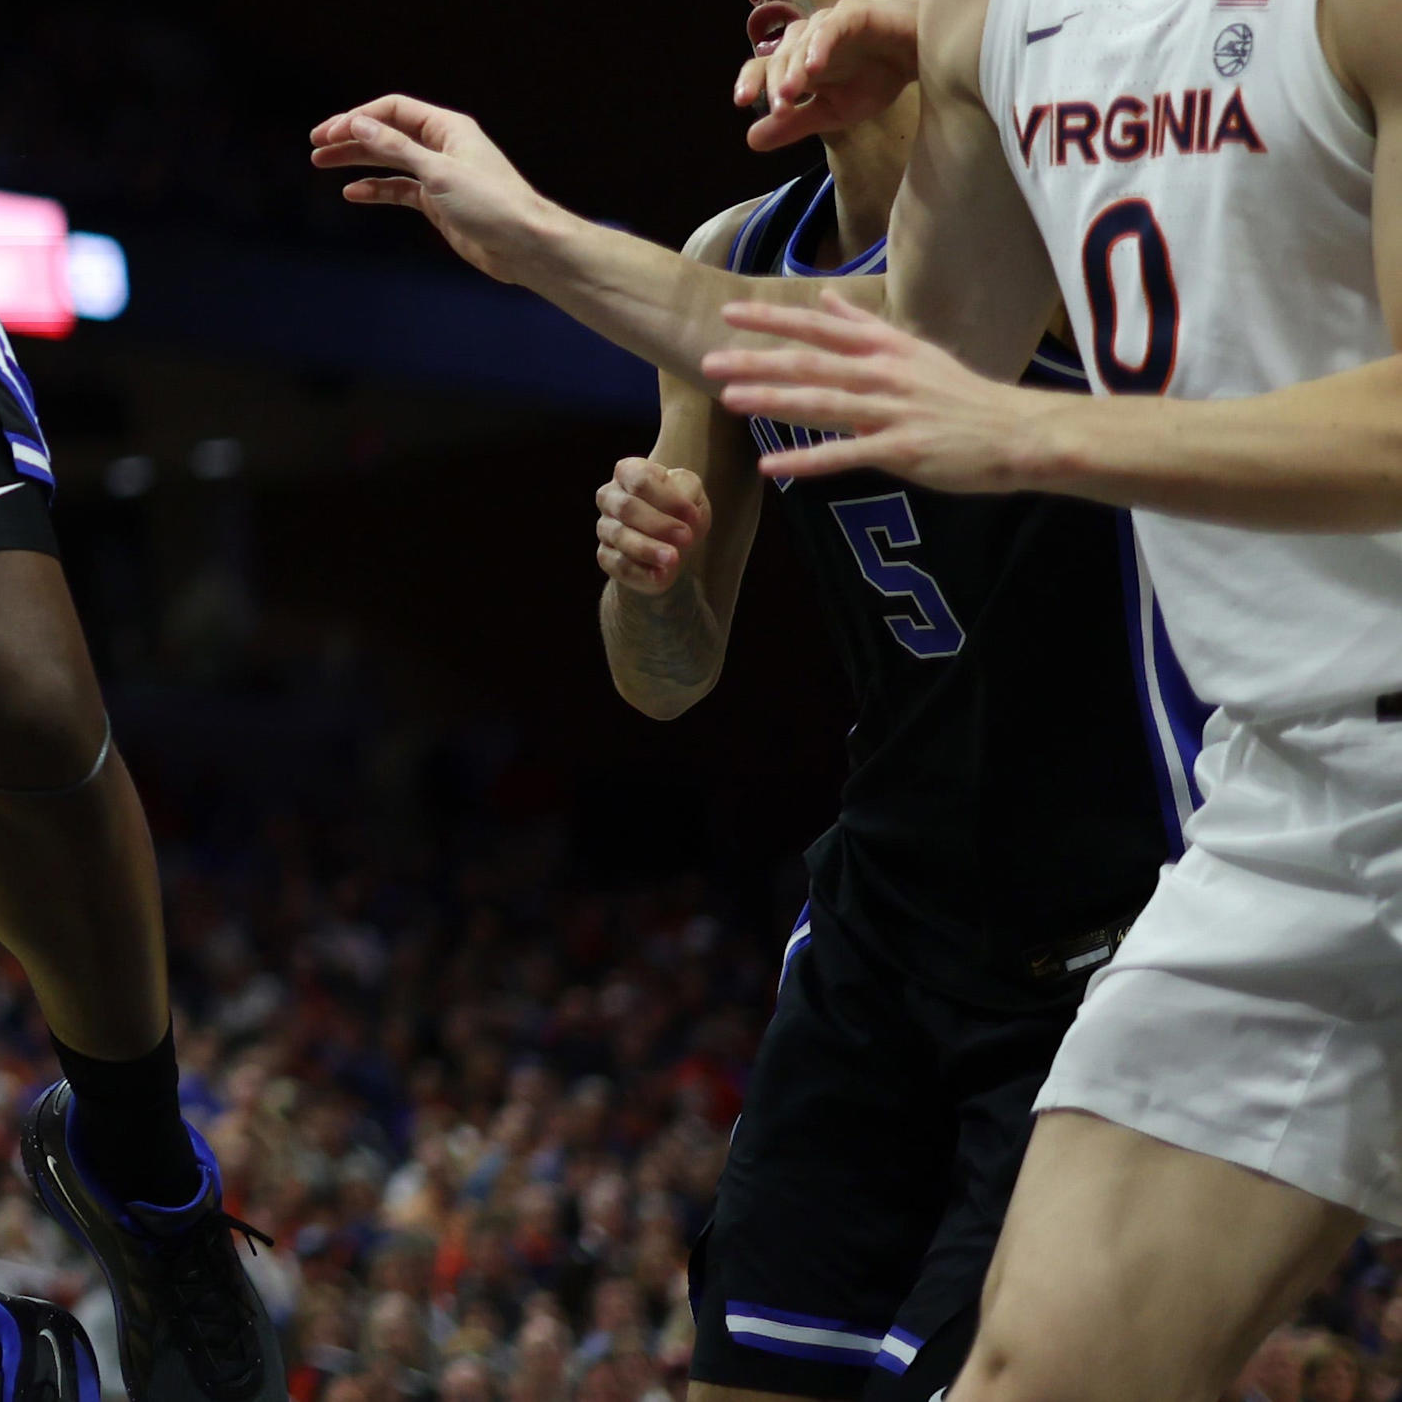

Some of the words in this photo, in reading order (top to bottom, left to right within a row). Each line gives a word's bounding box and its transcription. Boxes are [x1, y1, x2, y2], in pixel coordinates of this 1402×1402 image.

[1013, 86, 1269, 169] VRGINIA
[1082, 196, 1181, 397] 0
[828, 490, 966, 660] 5
